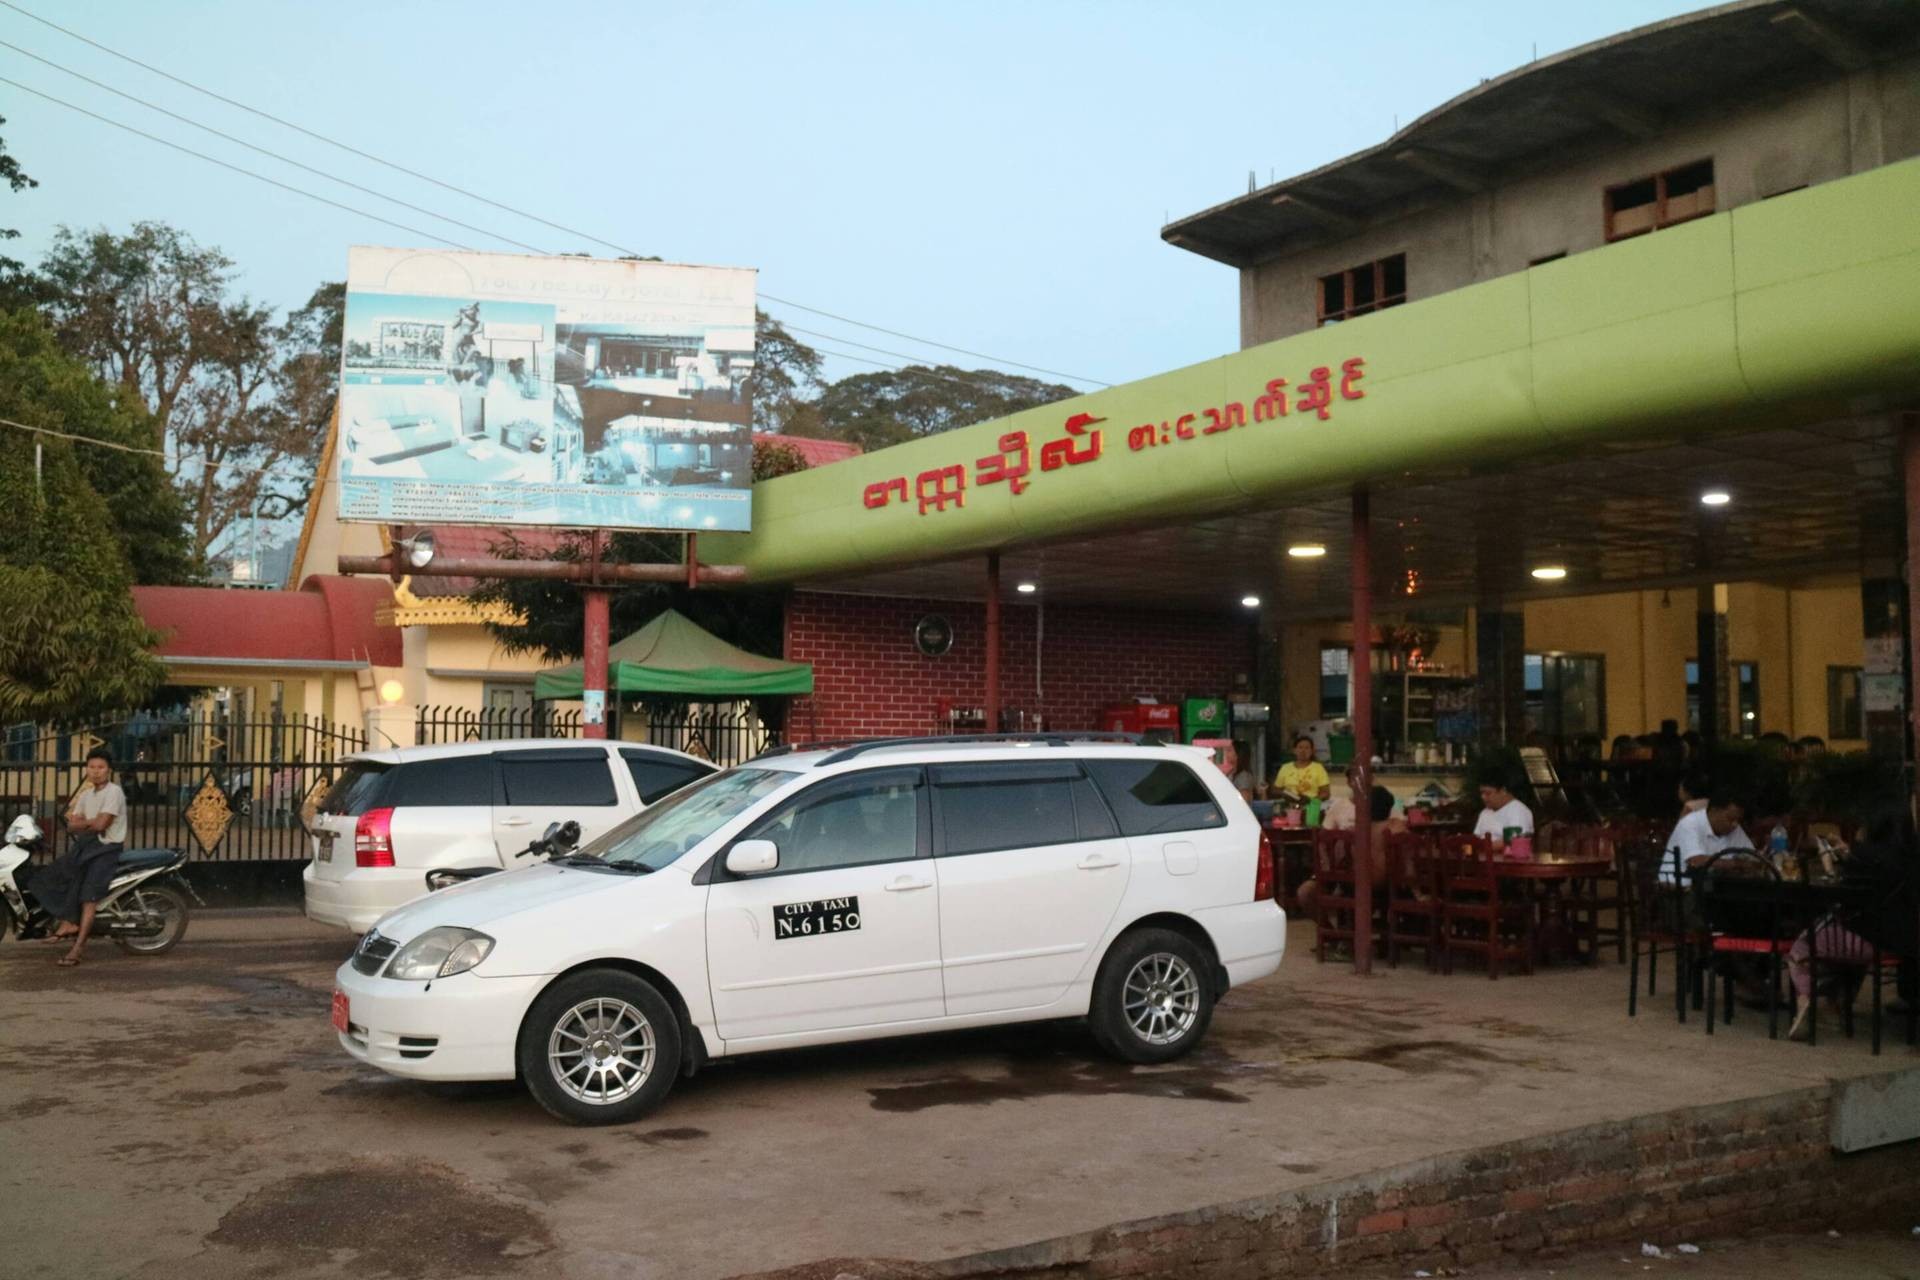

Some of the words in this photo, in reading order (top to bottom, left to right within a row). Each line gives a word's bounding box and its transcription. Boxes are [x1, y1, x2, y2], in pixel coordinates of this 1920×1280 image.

[1128, 357, 1366, 451] စားသောက်ဆိုင်
[784, 902, 814, 915] CITY
[821, 897, 850, 911] TAXI
